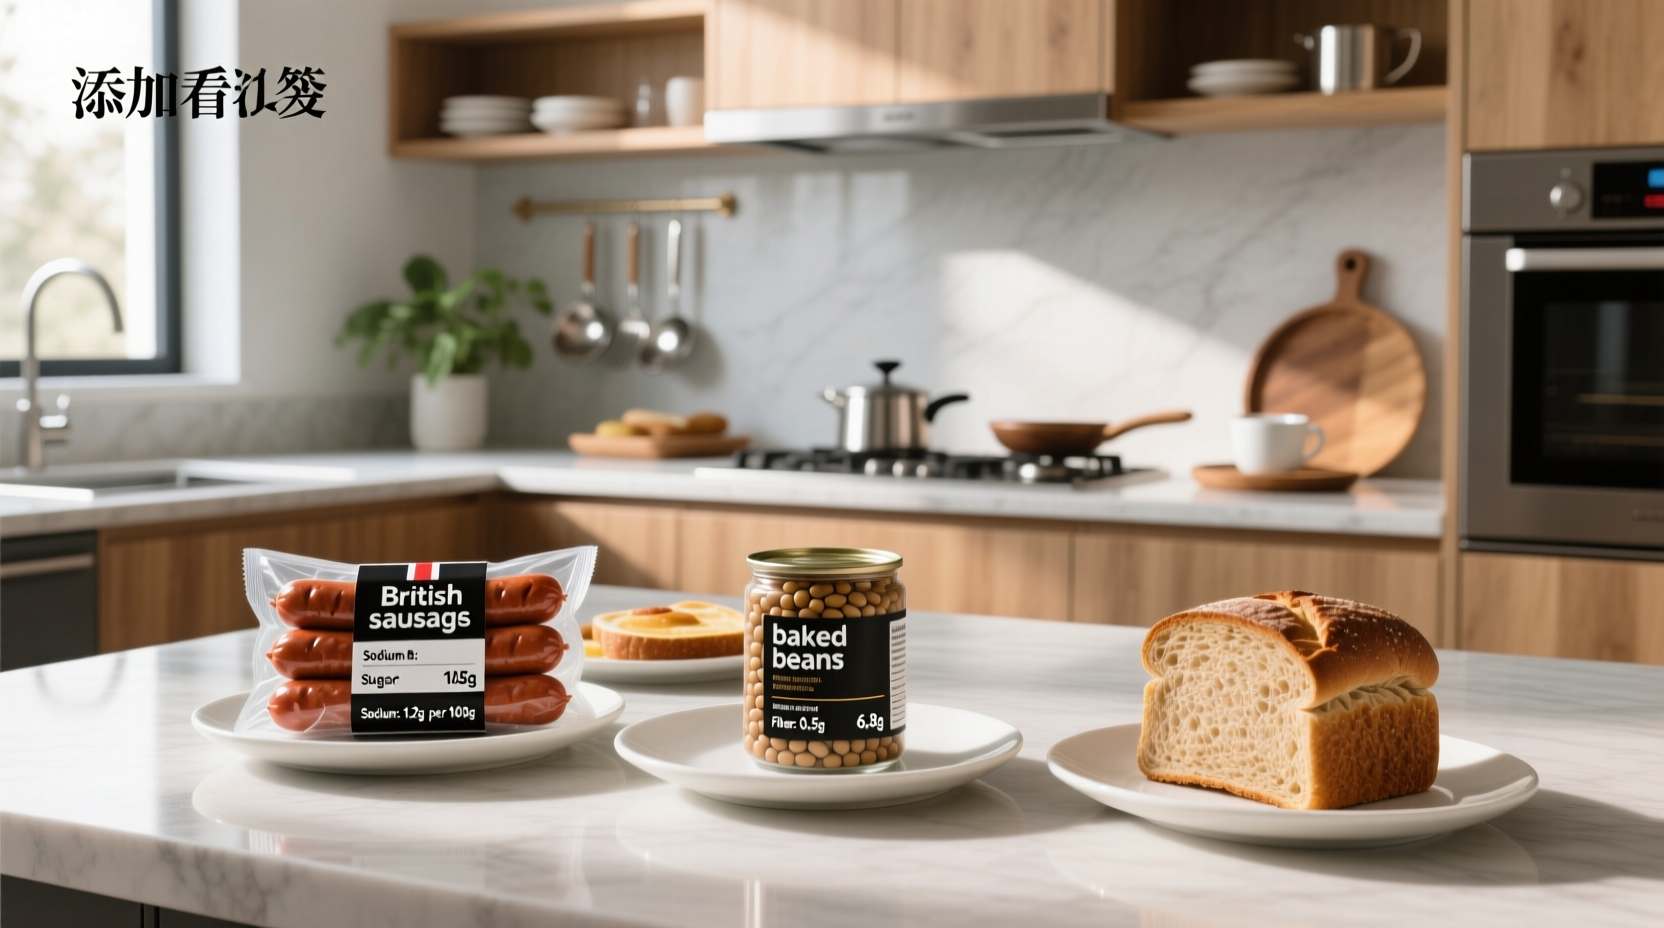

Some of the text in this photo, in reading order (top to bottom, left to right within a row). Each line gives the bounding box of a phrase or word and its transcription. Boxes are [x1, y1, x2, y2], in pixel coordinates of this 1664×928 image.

[381, 583, 463, 607] British
[369, 610, 471, 634] sausags
[772, 623, 847, 647] baked
[772, 647, 845, 670] beans
[428, 710, 447, 722] per
[799, 716, 826, 734] 0.5g
